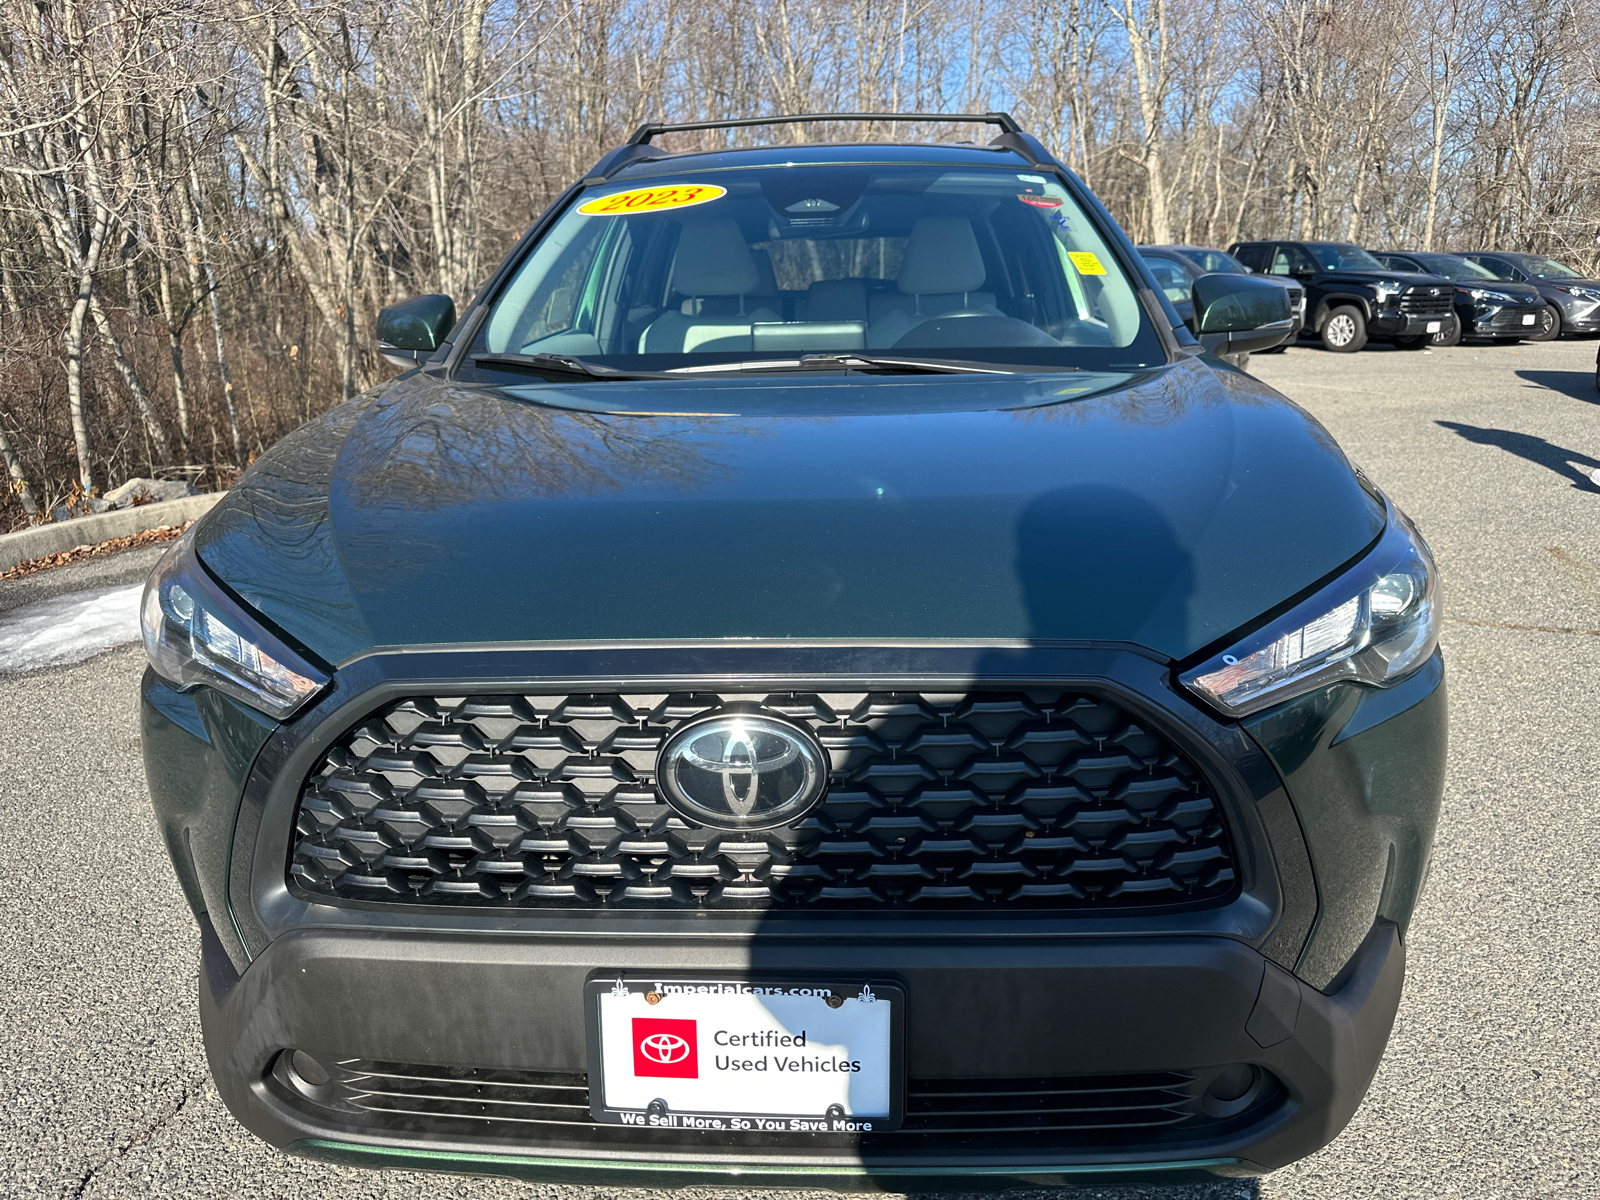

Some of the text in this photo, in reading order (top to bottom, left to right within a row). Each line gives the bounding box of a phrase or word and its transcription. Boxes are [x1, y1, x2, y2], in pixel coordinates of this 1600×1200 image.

[599, 188, 703, 212] 2023
[654, 983, 832, 998] Imperialcars.com
[714, 1030, 806, 1047] Certified
[715, 1055, 861, 1073] Used Vehicles
[620, 1112, 872, 1131] We Sell More, So You Save More
